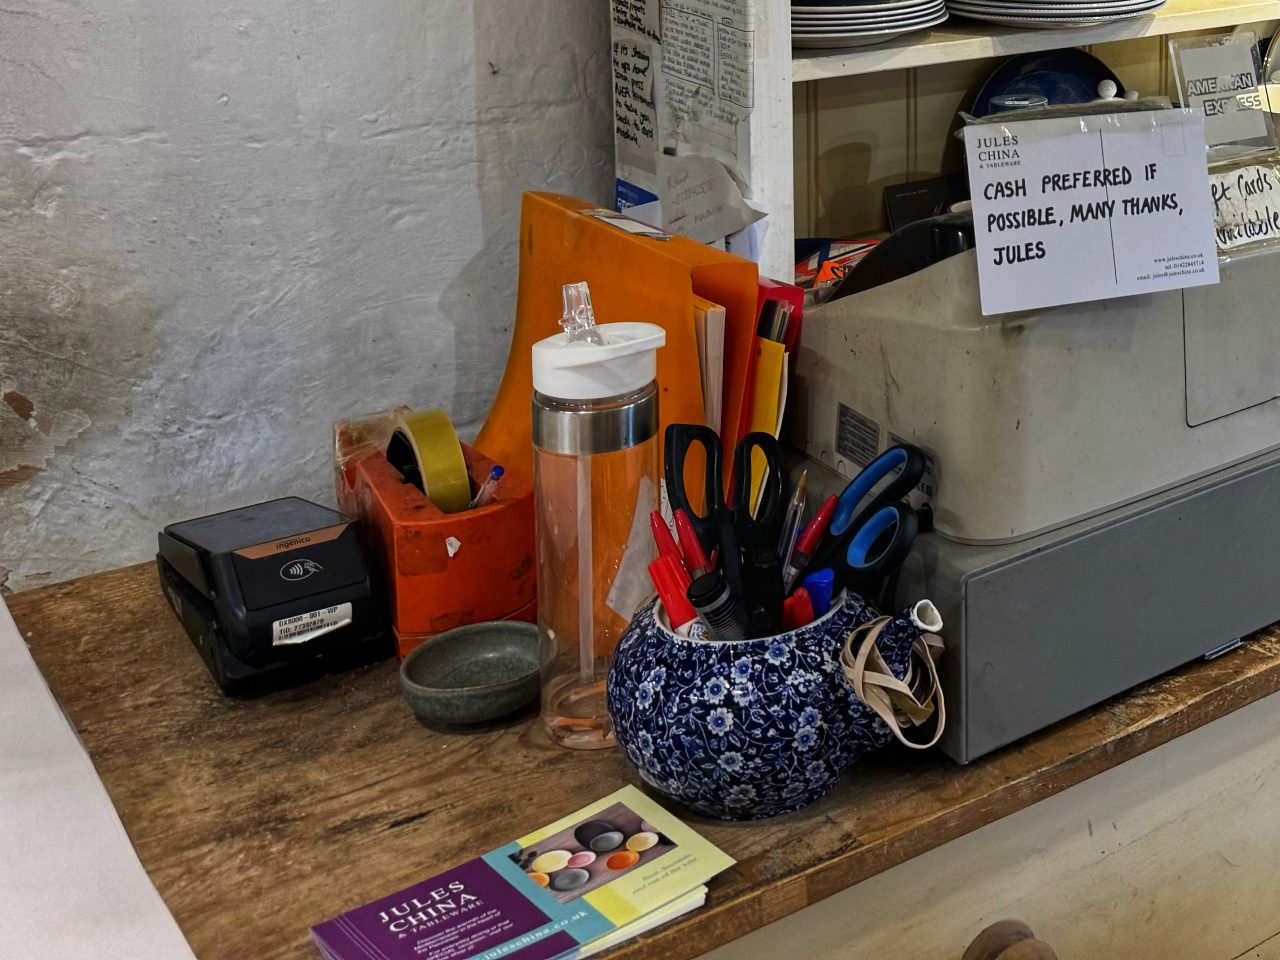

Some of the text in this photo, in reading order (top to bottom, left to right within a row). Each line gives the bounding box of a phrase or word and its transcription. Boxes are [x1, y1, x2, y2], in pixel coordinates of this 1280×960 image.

[977, 135, 1019, 149] JULES
[978, 148, 1020, 162] CHINA
[986, 160, 1021, 169] TABLEWARE
[984, 163, 1157, 200] CASH PREFERRED IF
[1237, 168, 1273, 199] Cards
[987, 193, 1183, 233] POSSIBLE, MANY THANKS,
[993, 241, 1046, 266] JULES
[276, 536, 311, 550] ingenico
[379, 881, 465, 923] JULES
[389, 893, 478, 933] CHINA
[410, 900, 484, 933] TABLEWARE
